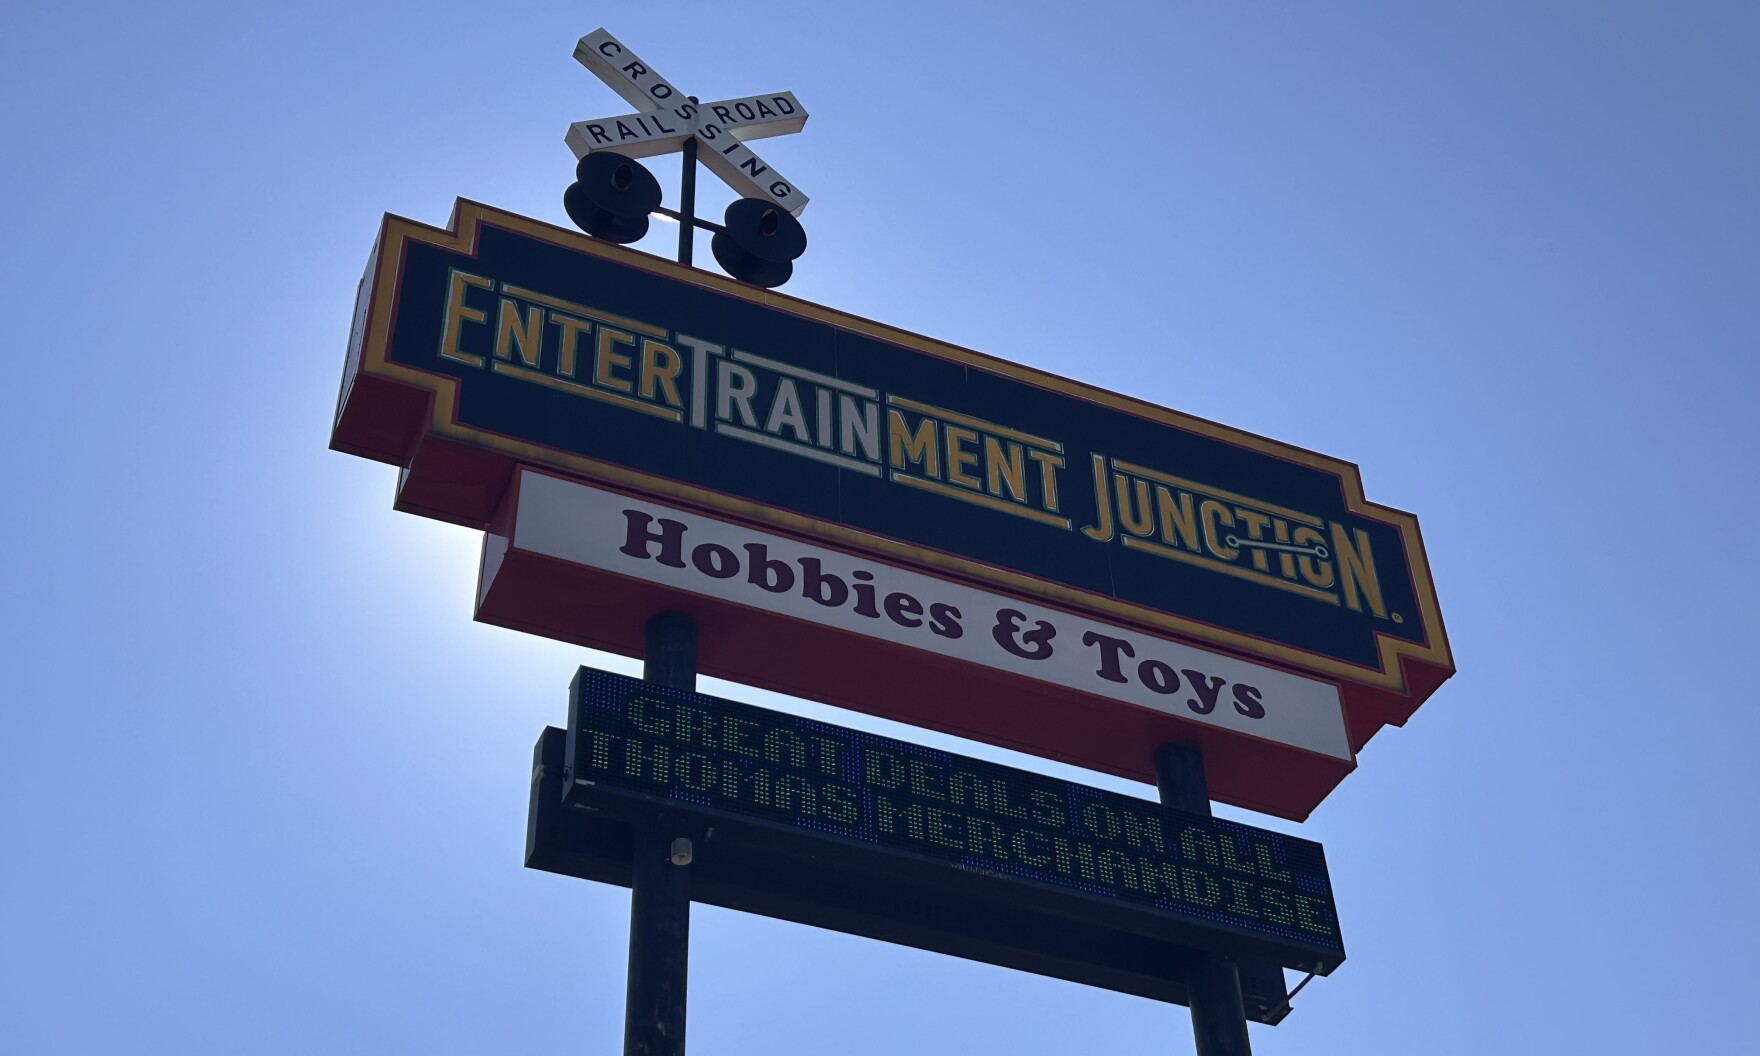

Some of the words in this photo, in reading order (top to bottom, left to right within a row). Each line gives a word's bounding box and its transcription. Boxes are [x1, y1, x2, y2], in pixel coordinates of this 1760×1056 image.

[599, 41, 791, 198] CROSSING
[619, 509, 964, 640] Hobbies
[992, 608, 1057, 661] &
[1082, 630, 1266, 720] Toys
[583, 727, 859, 824] THOMAS
[877, 794, 1333, 936] MERCHANDISE
[627, 695, 845, 775] GREAT
[865, 748, 1066, 830] DEALS
[1083, 801, 1166, 855] ON
[1180, 824, 1293, 883] ALL
